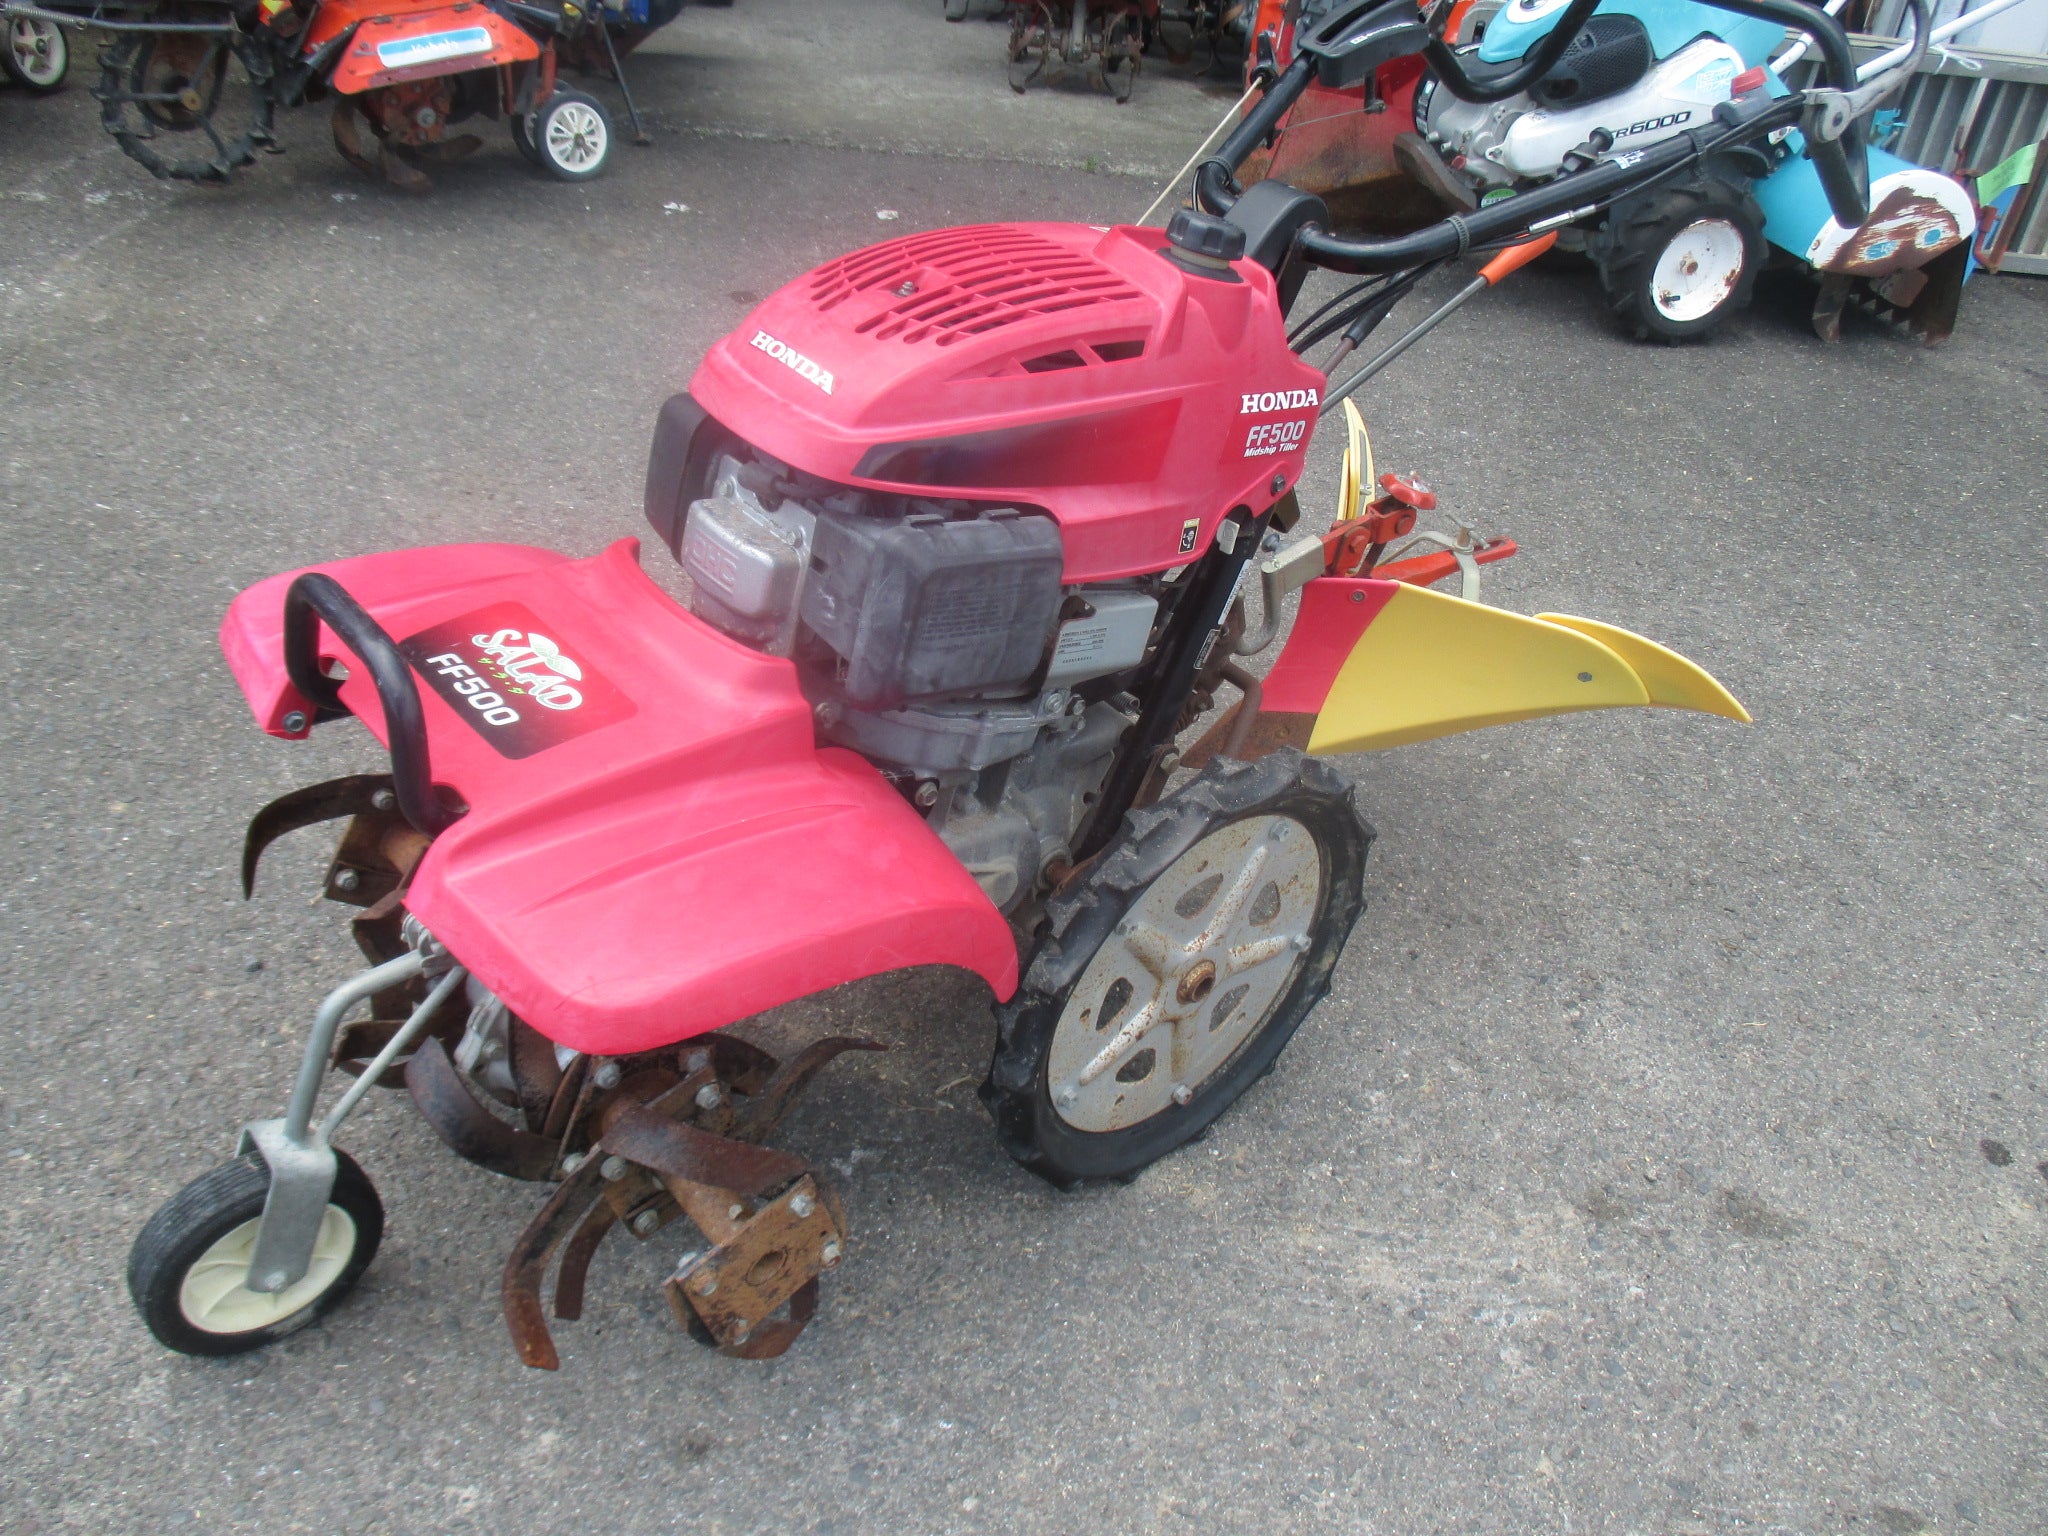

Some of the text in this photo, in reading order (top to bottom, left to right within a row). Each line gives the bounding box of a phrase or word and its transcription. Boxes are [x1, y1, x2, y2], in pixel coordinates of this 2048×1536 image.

[1612, 111, 1692, 138] R6000
[749, 329, 834, 396] HONDA
[1240, 388, 1319, 414] HONDA
[1246, 420, 1306, 447] FF500
[1243, 442, 1299, 458] Midship Tiller
[471, 628, 583, 711] SALAD
[426, 652, 520, 726] FF500
